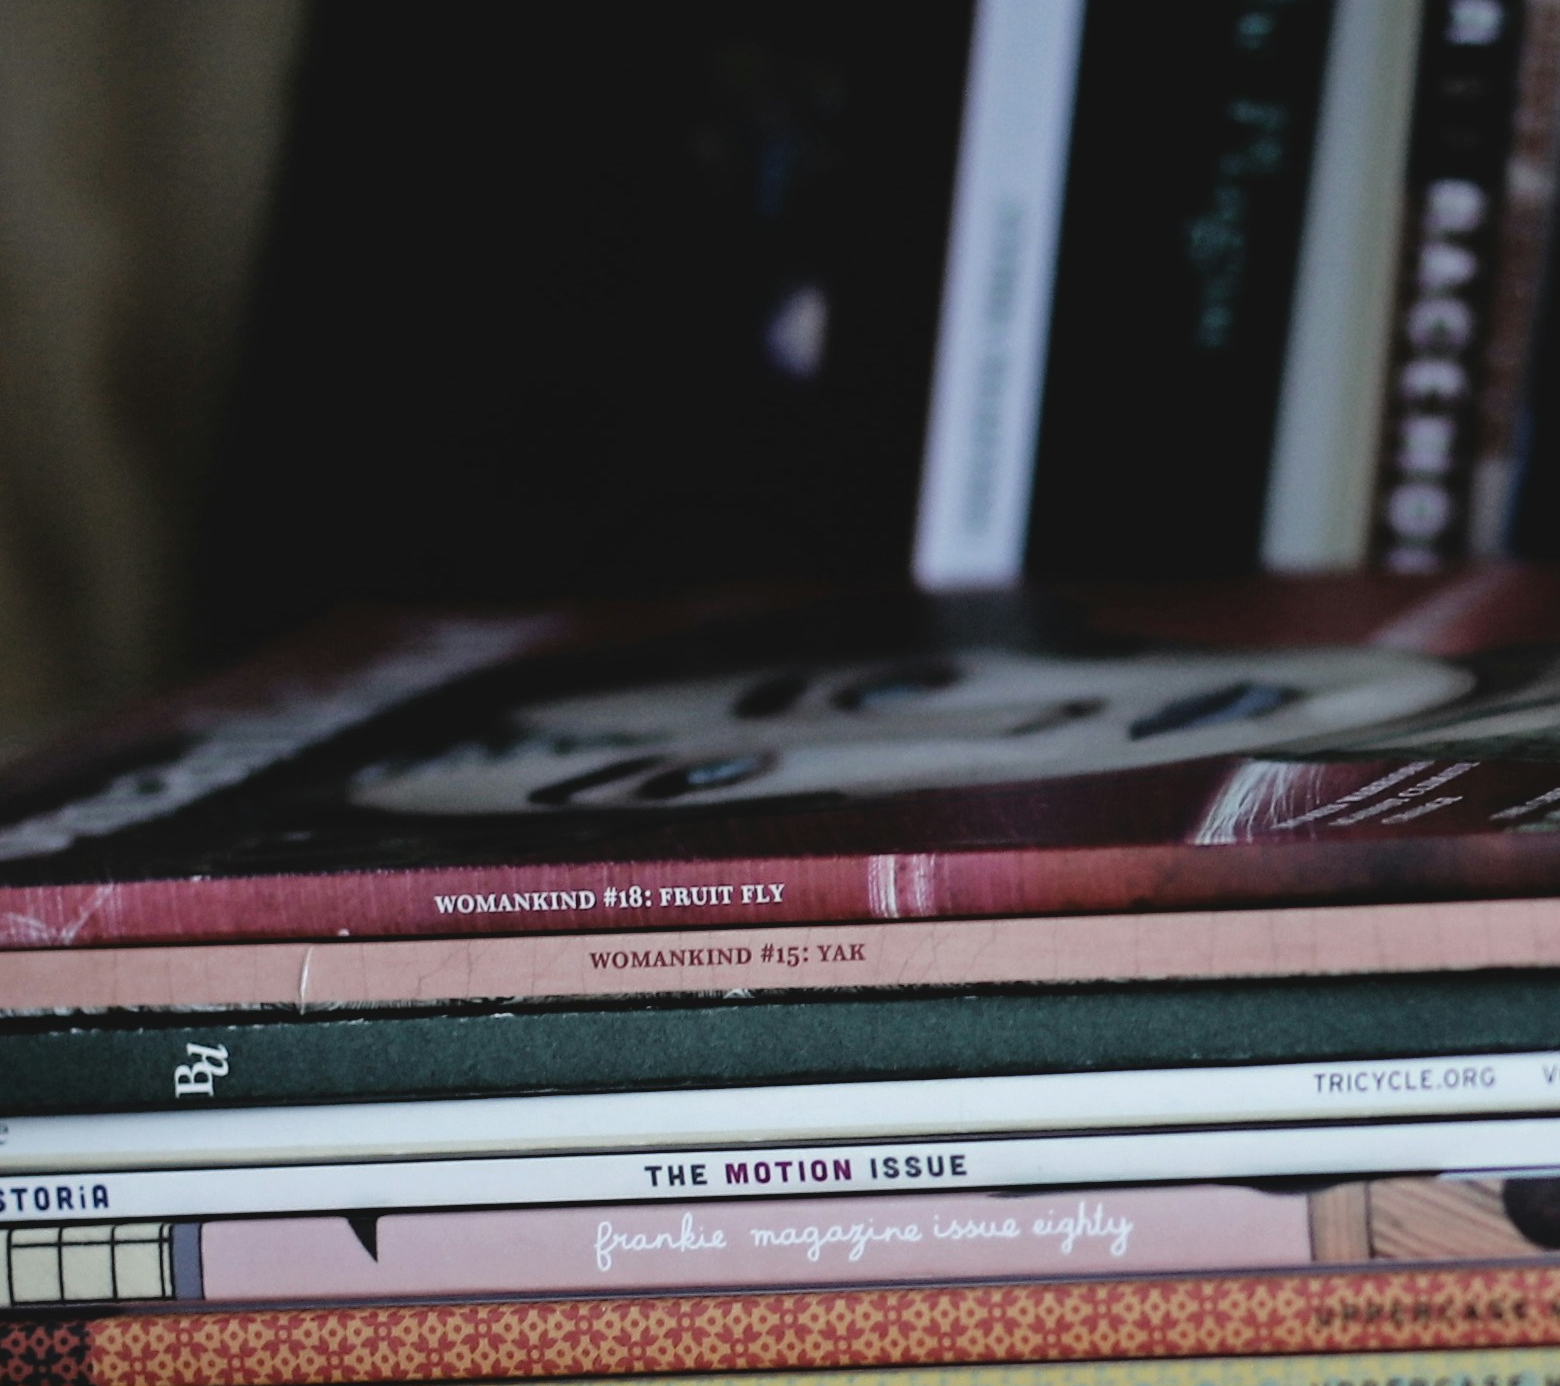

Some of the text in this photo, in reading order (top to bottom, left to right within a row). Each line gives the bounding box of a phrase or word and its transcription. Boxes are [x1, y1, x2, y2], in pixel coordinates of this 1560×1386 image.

[435, 883, 786, 914] WOMANKIND #18: FRUIT FLY
[589, 943, 867, 970] WOMANKIND #15: YAK
[1312, 1067, 1497, 1095] TRICYCLE.ORG
[644, 1154, 968, 1188] THE MOTION ISSUE
[593, 1203, 1133, 1272] frankie magazine issue eighty
[1313, 1300, 1528, 1328] UPPERCASE
